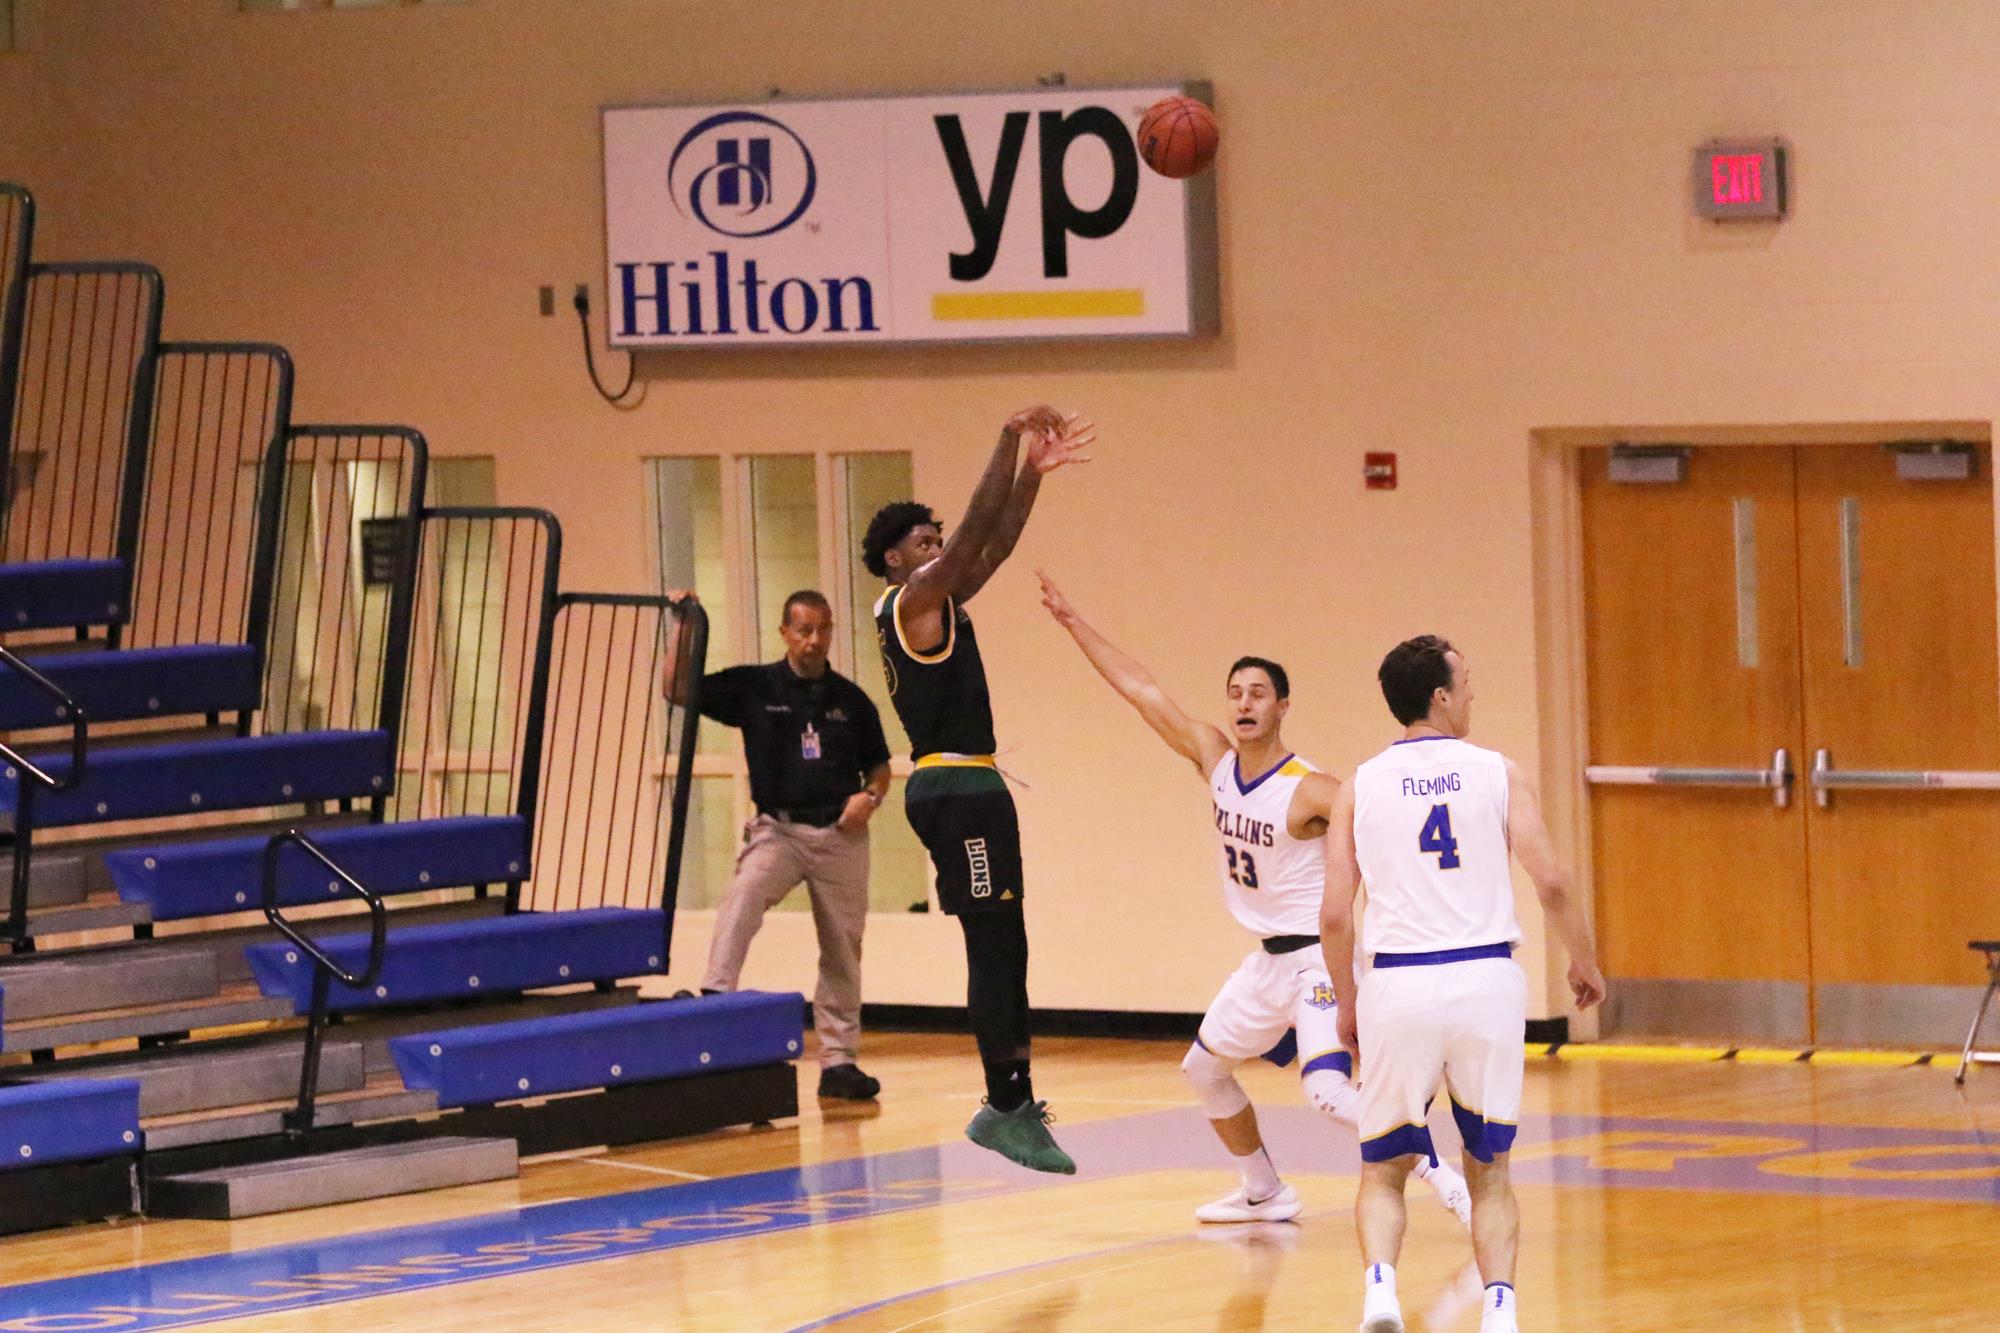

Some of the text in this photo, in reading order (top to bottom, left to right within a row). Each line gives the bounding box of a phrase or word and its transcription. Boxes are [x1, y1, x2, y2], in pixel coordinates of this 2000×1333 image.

[933, 106, 1139, 282] yp
[1711, 154, 1763, 204] EXIT
[615, 250, 881, 338] Hilton
[1402, 772, 1461, 796] FLEMING
[1213, 800, 1274, 848] LLINS
[1418, 803, 1460, 870] 4
[965, 838, 991, 898] LIONS
[1224, 844, 1258, 890] 23
